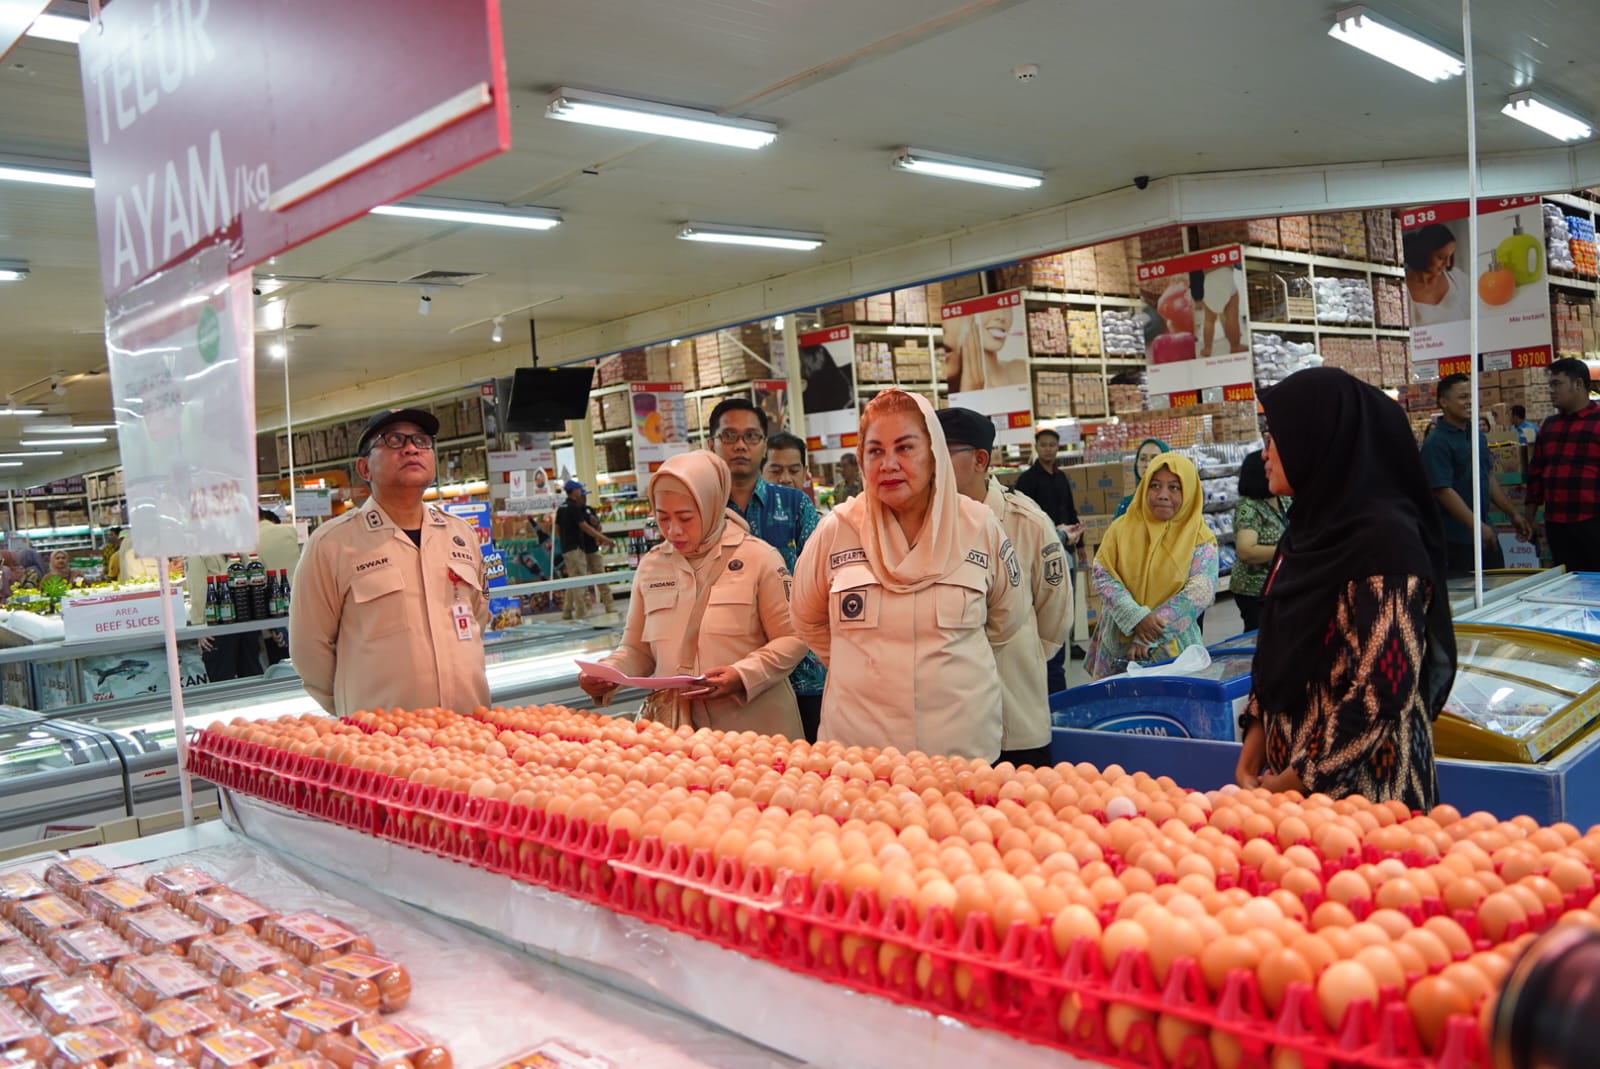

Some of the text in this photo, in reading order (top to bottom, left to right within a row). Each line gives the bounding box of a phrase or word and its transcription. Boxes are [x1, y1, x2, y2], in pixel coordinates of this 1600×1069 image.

[90, 0, 216, 144] TELUR
[1417, 210, 1436, 223] 38
[1150, 253, 1227, 275] 40 39
[1517, 352, 1546, 367] 39700
[356, 557, 389, 571] ISWAR
[967, 552, 985, 565] OTA
[650, 581, 676, 589] ENDANG
[115, 607, 139, 617] AREA
[95, 616, 160, 633] BEEF SLICES
